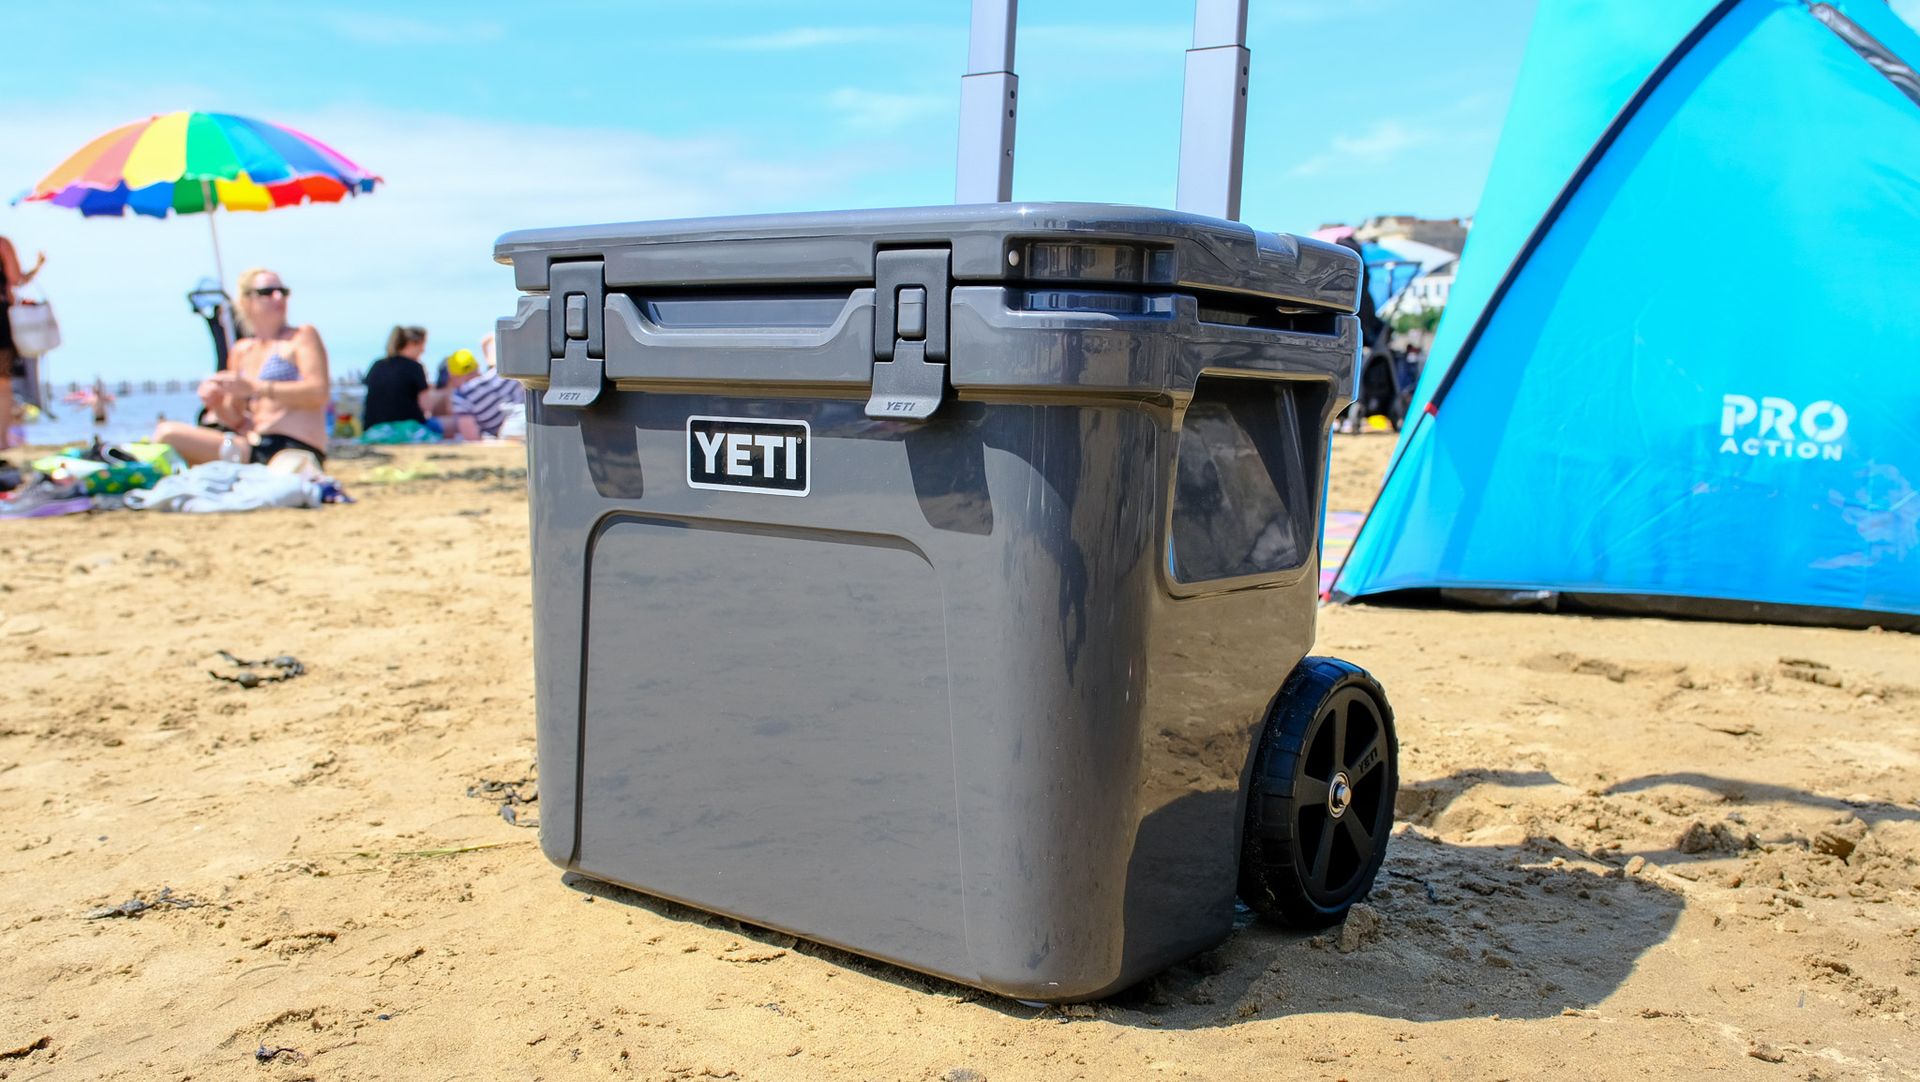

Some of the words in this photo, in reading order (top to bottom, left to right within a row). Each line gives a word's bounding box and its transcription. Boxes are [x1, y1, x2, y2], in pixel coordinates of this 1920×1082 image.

[559, 392, 581, 401] YETI
[886, 401, 916, 411] YETI
[1720, 394, 1848, 443] PRO
[1720, 437, 1843, 461] ACTION
[1358, 746, 1378, 773] YETI
